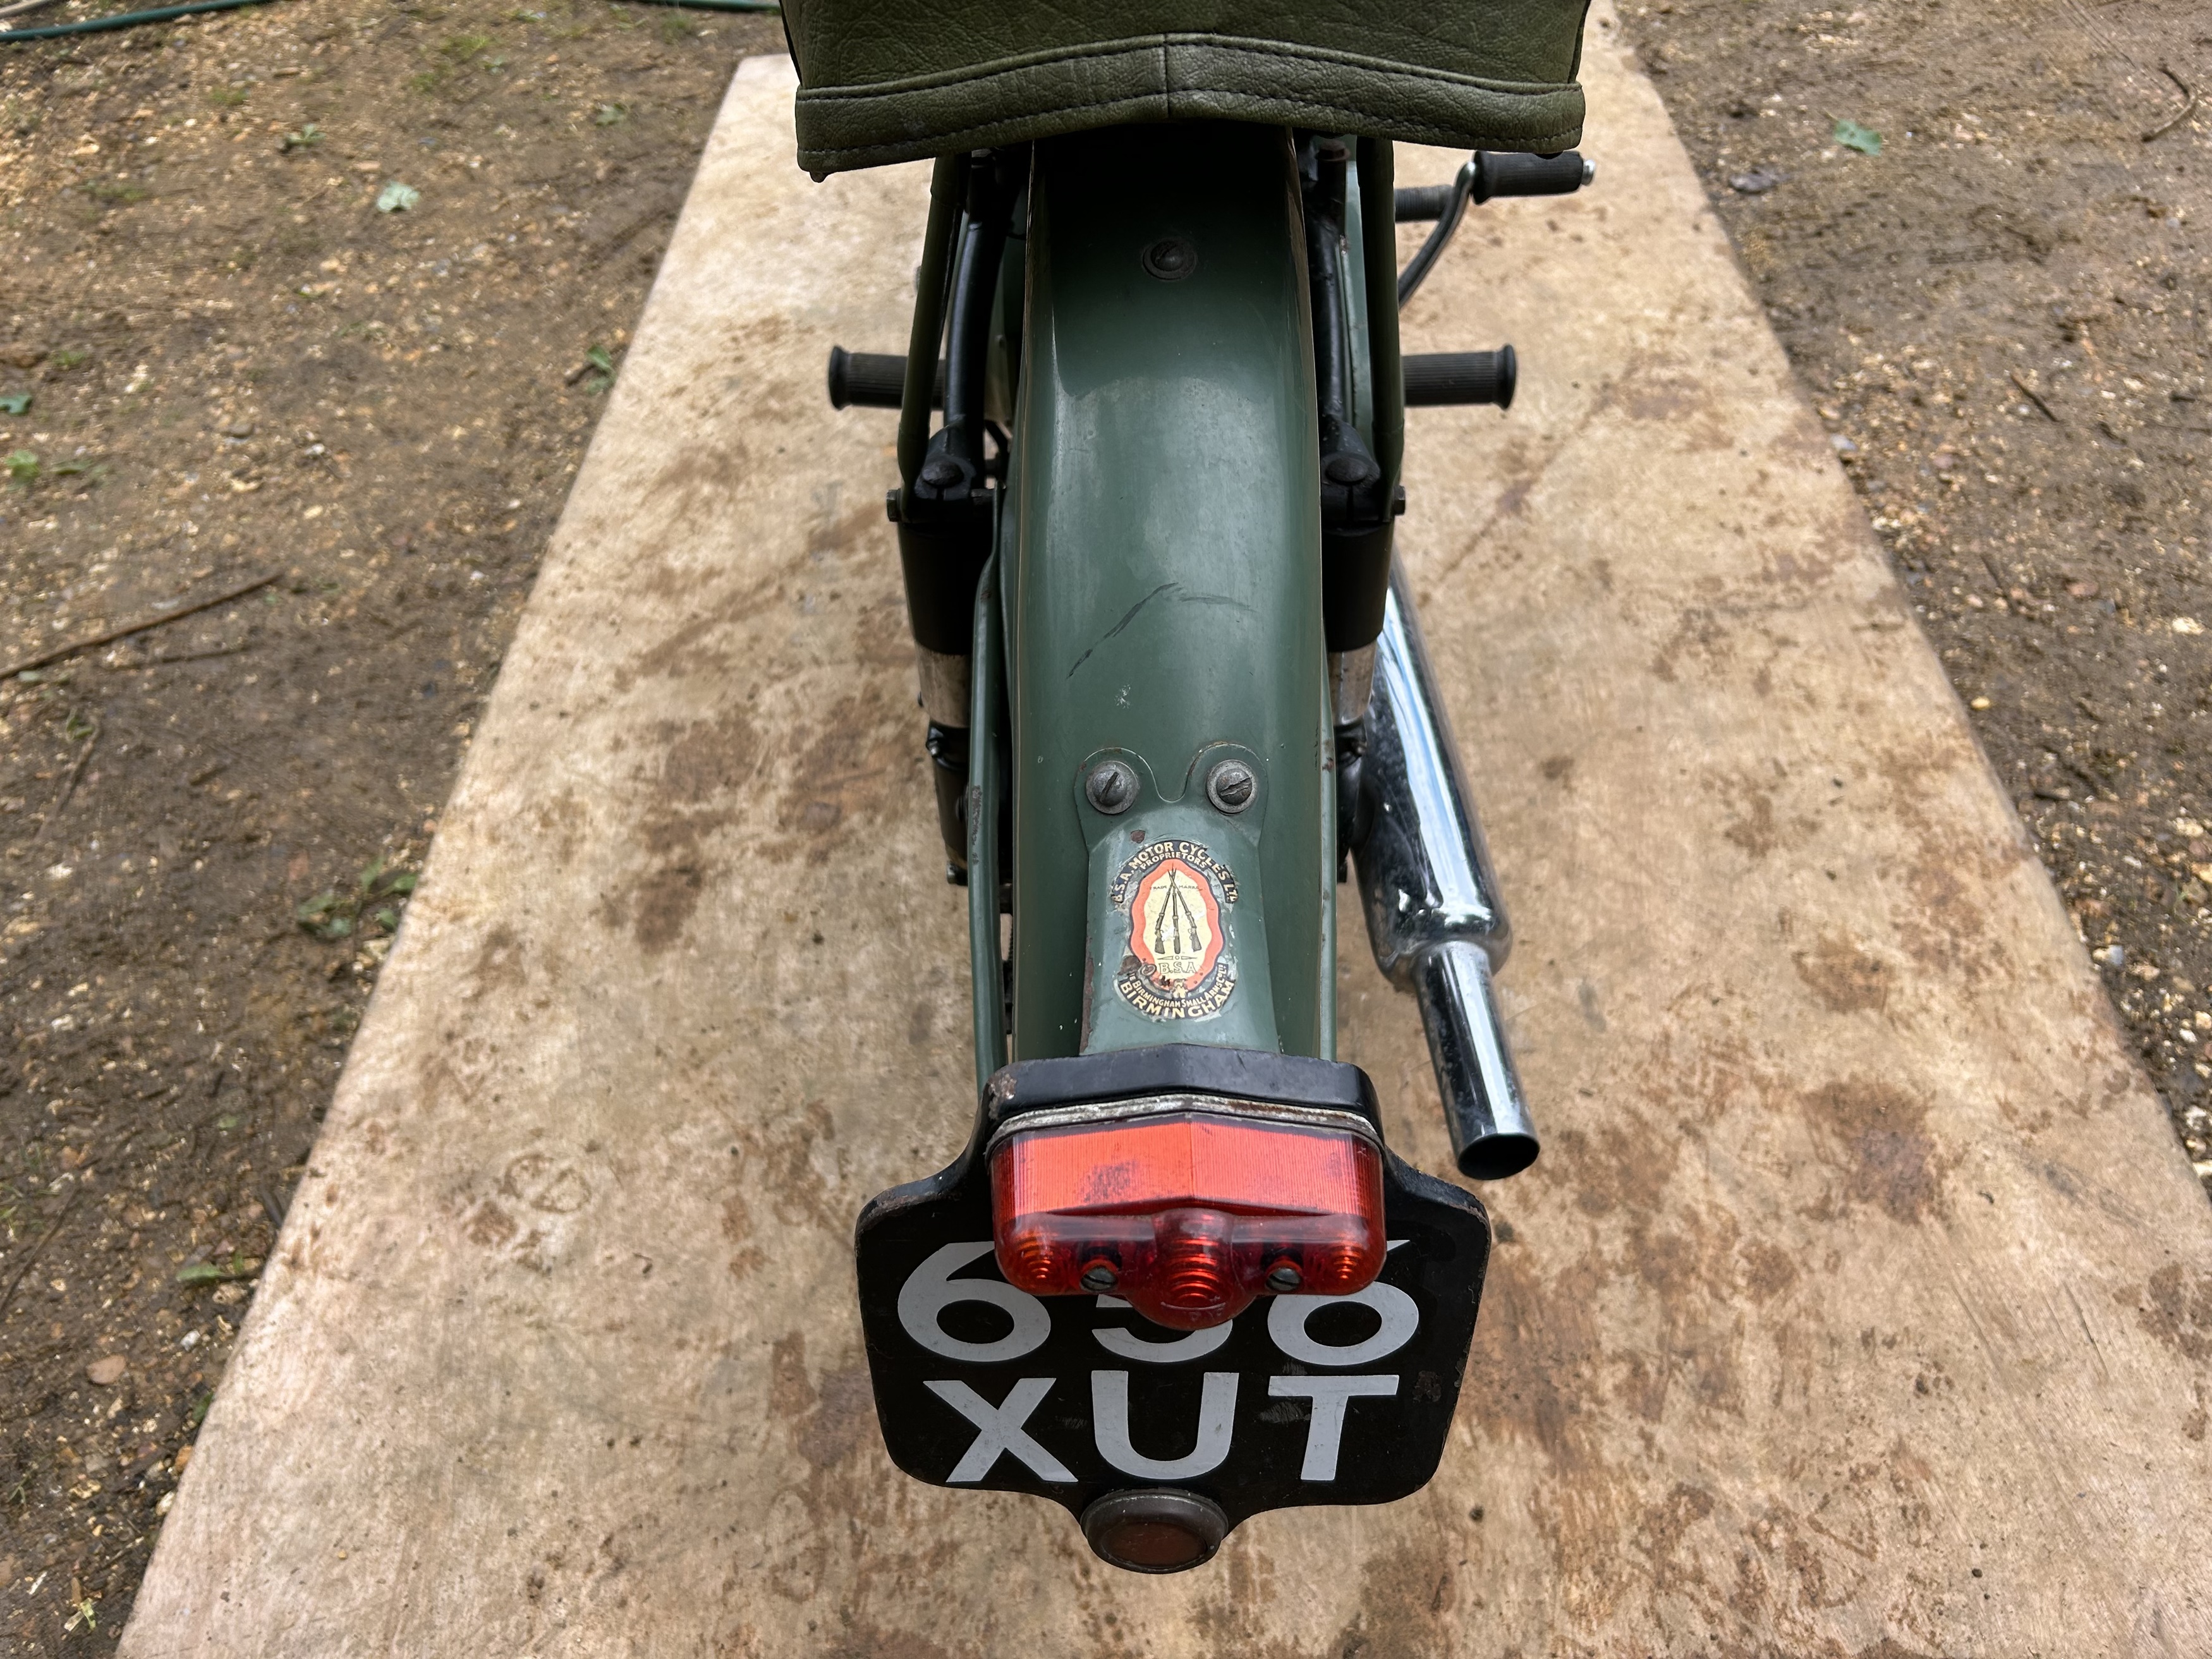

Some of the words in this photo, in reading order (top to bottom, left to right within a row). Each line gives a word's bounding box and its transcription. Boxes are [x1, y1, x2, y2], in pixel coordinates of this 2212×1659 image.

[1128, 842, 1174, 870] MOTOR
[1179, 842, 1231, 880] CYCLES
[1139, 852, 1207, 870] PROPRIETORS
[1120, 980, 1234, 1018] BIRMINGHAM
[1132, 980, 1181, 1007] BIRMINGHAM
[1181, 997, 1206, 1007] SMALL
[1203, 981, 1223, 1000] ARMS
[922, 1370, 1399, 1483] XUT
